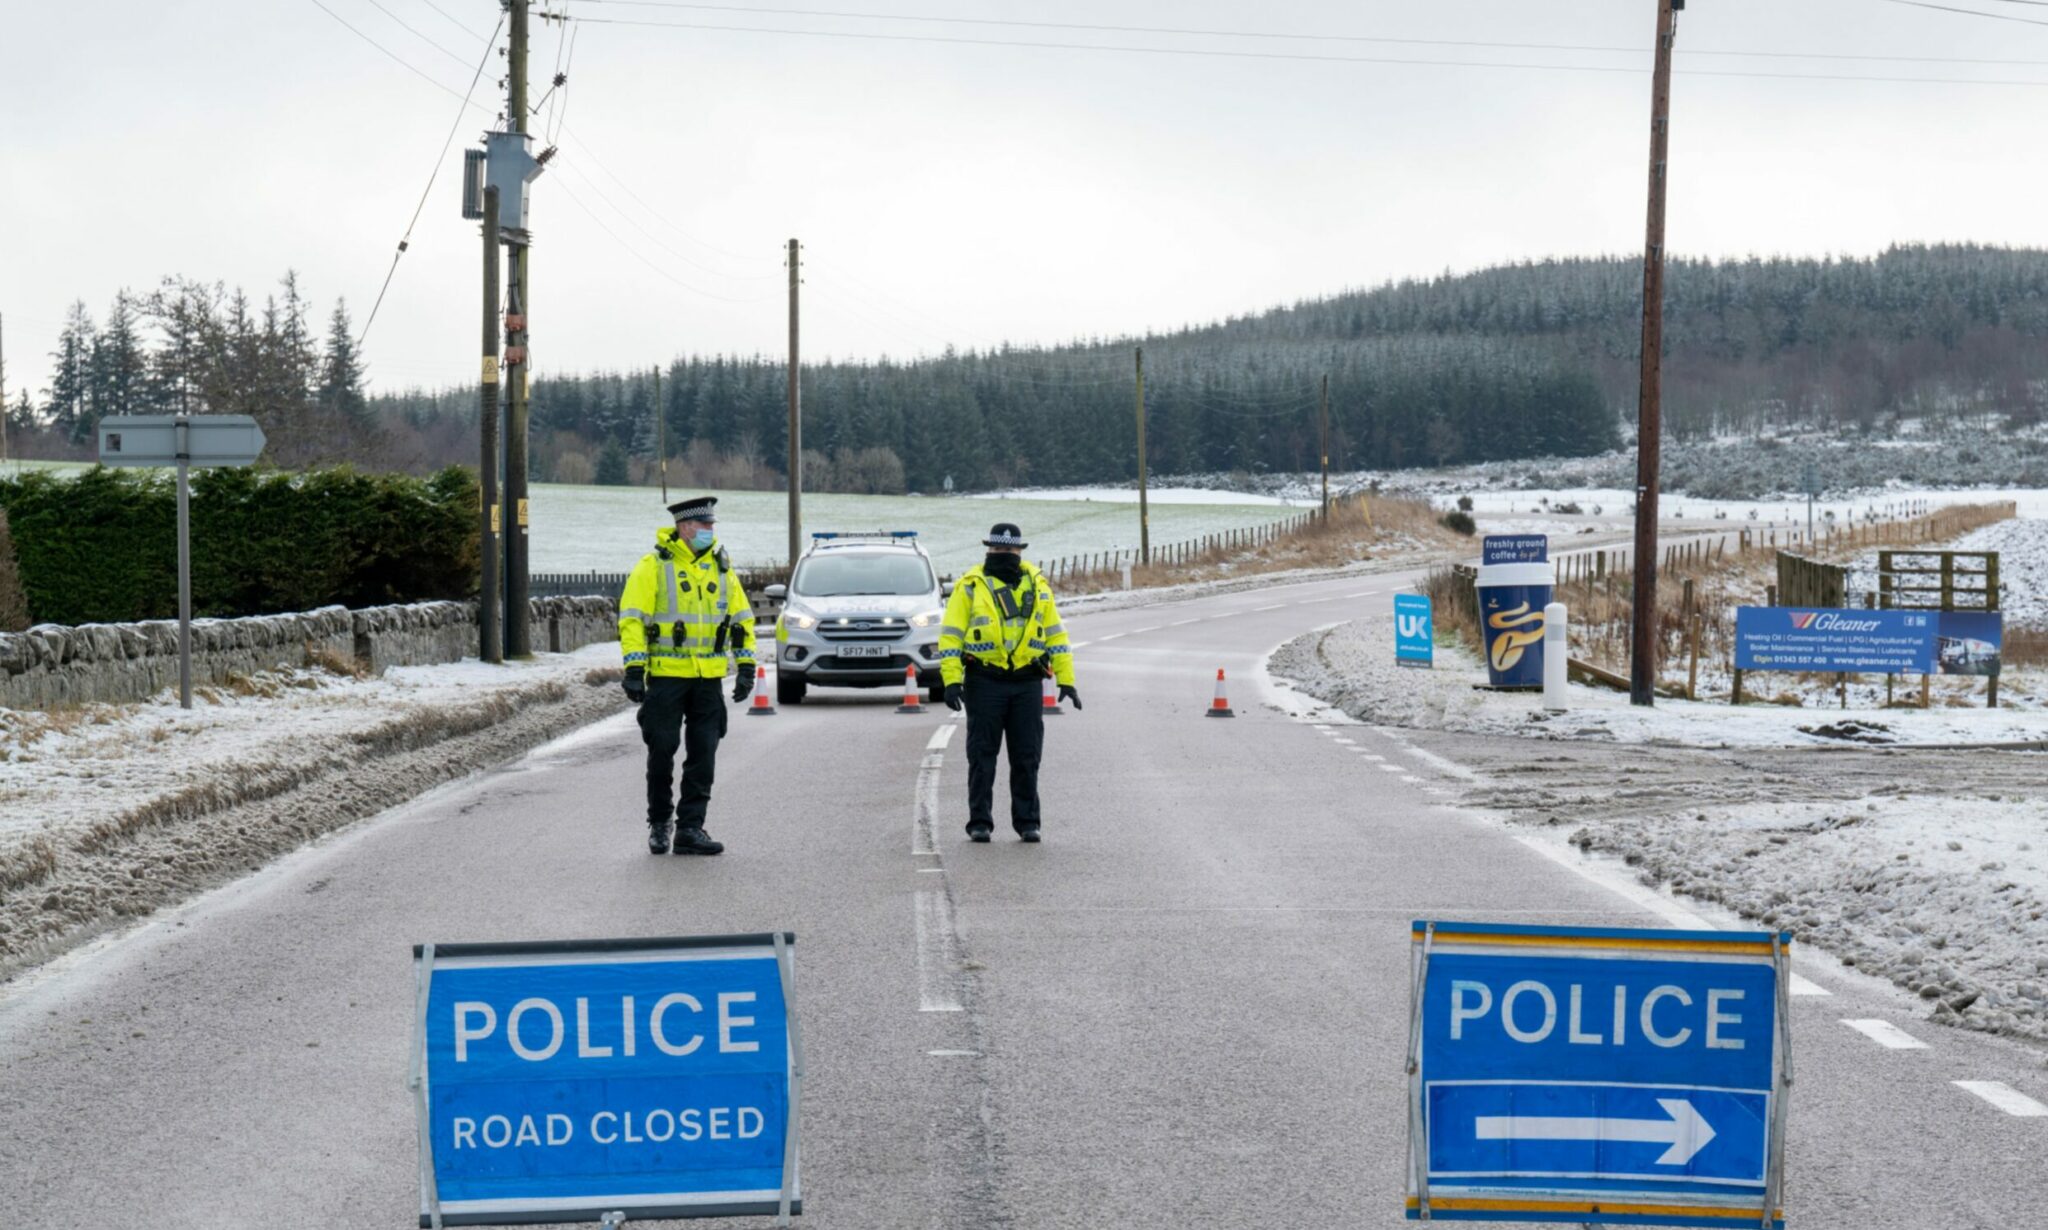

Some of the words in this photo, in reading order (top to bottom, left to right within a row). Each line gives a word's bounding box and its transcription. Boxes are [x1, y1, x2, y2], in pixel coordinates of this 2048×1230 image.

[1486, 539, 1514, 549] freshly
[1516, 539, 1545, 549] ground
[1490, 550, 1517, 559] coffee
[1398, 614, 1428, 640] UK
[1815, 613, 1882, 632] Gleaner
[1744, 634, 1771, 642] Heating
[1787, 634, 1827, 642] Commercial
[1829, 635, 1844, 643] Fuel
[1869, 637, 1907, 645] Agricultural
[843, 647, 863, 656] SF17
[865, 647, 884, 656] HNT
[1750, 643, 1769, 651] Boiler
[1771, 644, 1814, 652] Maintenance
[1849, 646, 1876, 654] Stations
[1881, 647, 1917, 655] Lubricants
[1753, 655, 1773, 664] Elgin
[1774, 655, 1797, 663] 01343
[1833, 657, 1914, 667] www.gleaner.co.uk
[1450, 980, 1746, 1050] POLICE
[454, 992, 760, 1062] POLICE
[453, 1114, 573, 1149] ROAD
[590, 1107, 764, 1144] CLOSED
